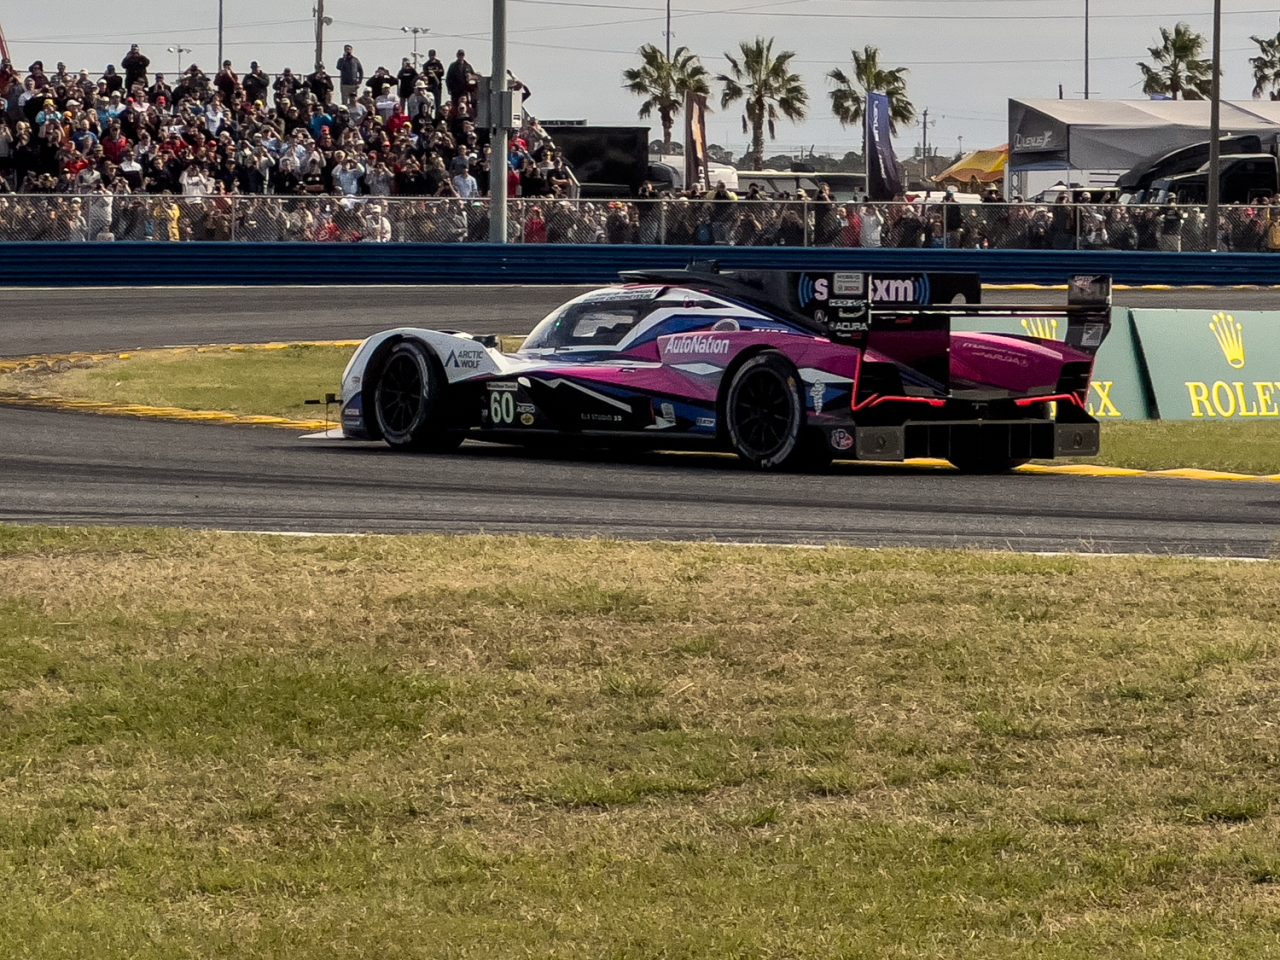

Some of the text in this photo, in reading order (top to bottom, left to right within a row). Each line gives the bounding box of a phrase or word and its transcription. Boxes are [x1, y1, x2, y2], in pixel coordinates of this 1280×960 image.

[835, 322, 869, 331] ACURA
[664, 336, 730, 354] AutoNation
[458, 350, 484, 360] ARCTIC
[461, 360, 480, 369] WOLF
[490, 391, 514, 423] 60
